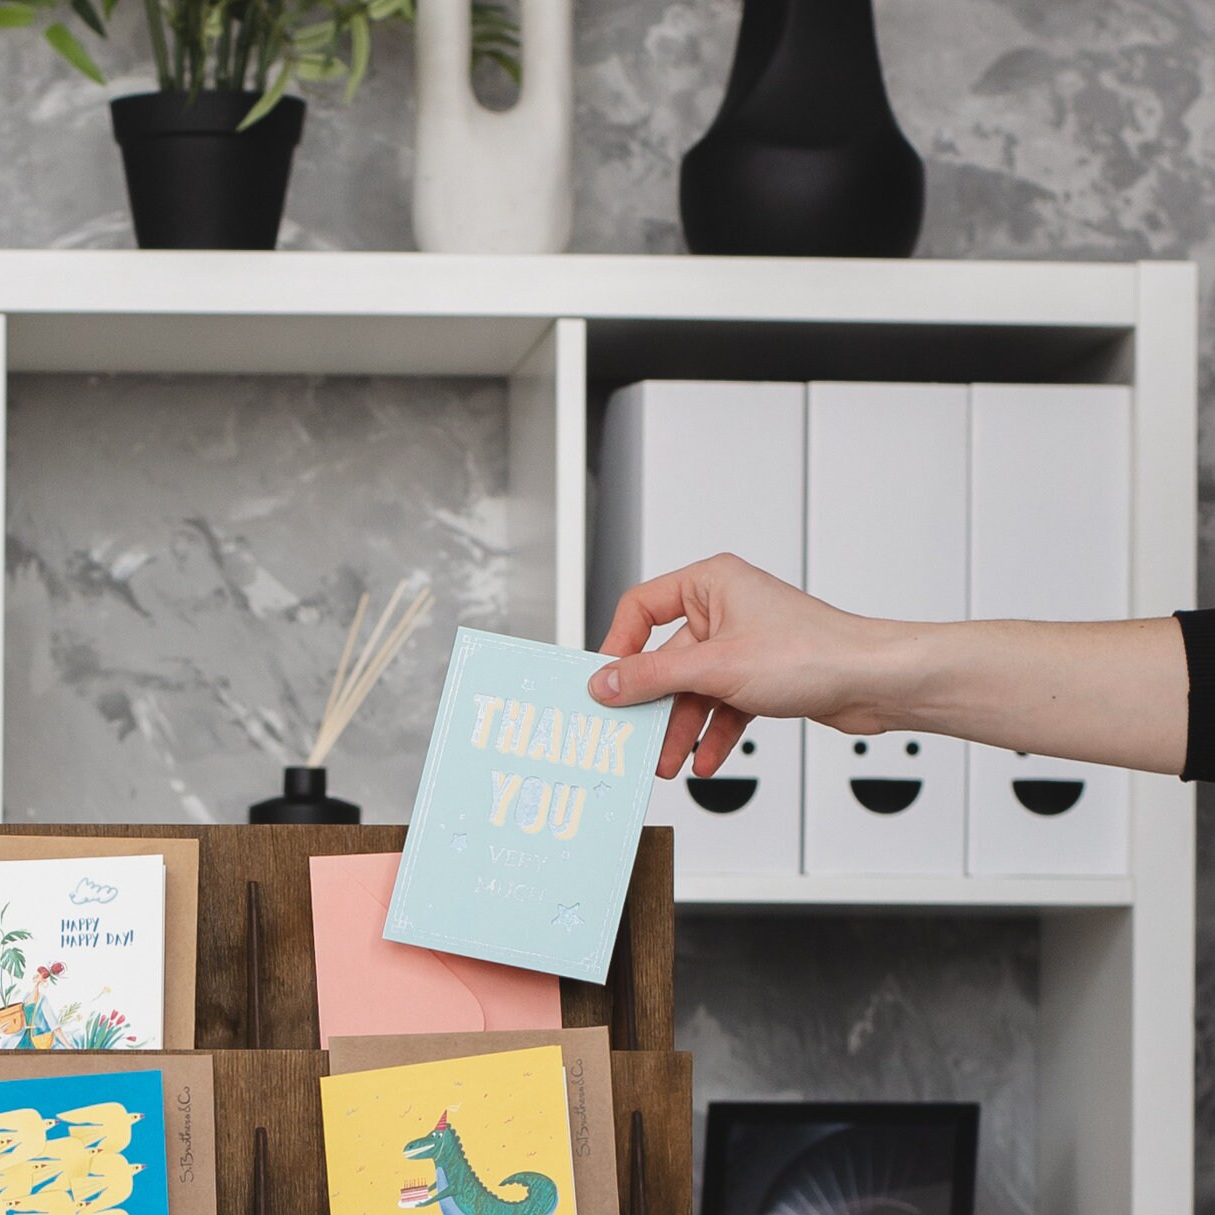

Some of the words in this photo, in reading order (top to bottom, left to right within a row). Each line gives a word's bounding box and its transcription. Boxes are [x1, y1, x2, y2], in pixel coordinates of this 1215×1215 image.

[470, 693, 634, 776] THANK
[488, 768, 586, 841] YOU
[61, 917, 100, 933] HAPPY
[61, 932, 100, 948] HAPPY
[106, 930, 135, 946] DAY!
